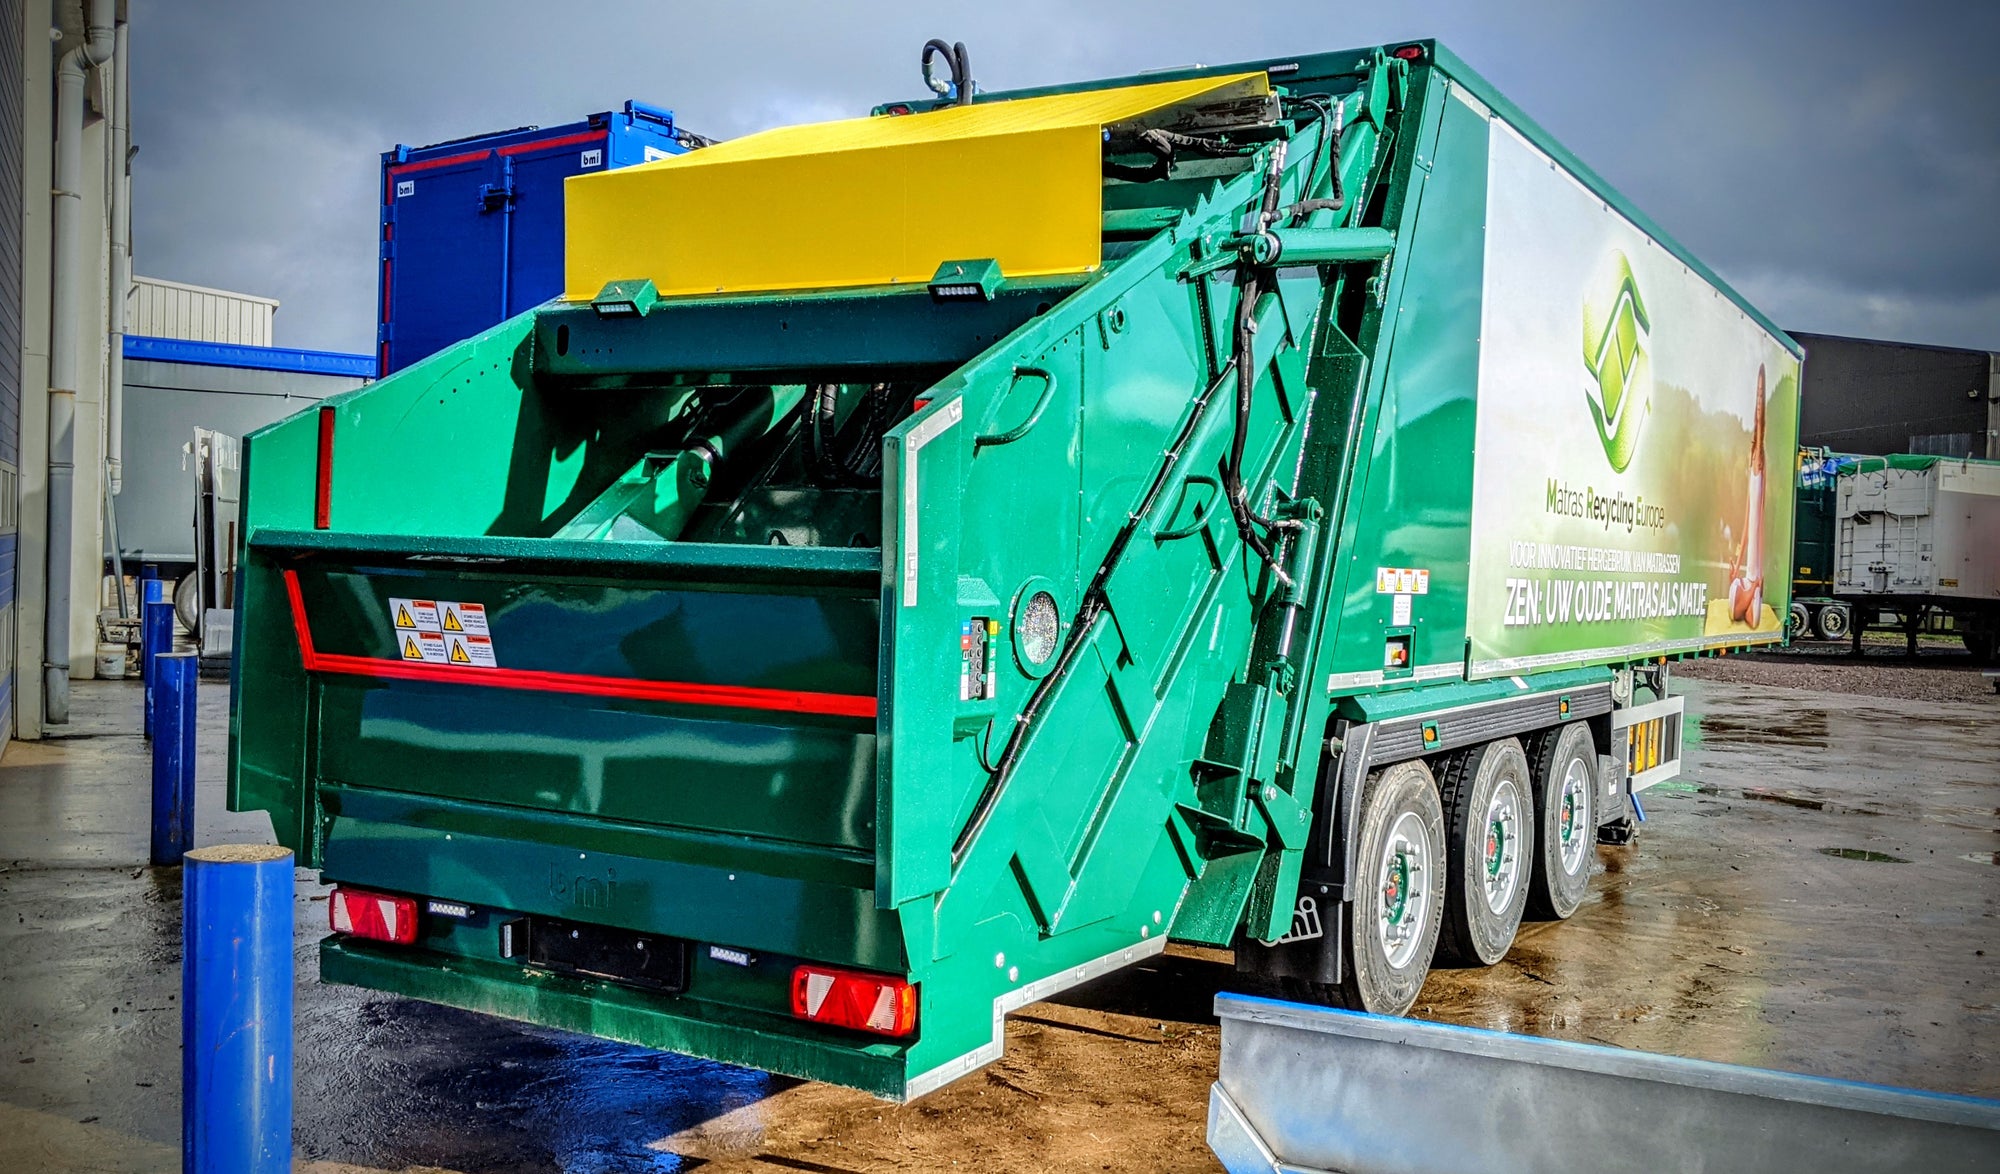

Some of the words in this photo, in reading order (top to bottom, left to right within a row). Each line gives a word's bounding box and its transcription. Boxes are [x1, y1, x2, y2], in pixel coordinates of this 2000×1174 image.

[583, 153, 600, 166] bmi
[399, 183, 413, 195] bmi
[1546, 477, 1583, 517] Matras
[1586, 486, 1634, 533] Recycling
[1636, 496, 1664, 536] Europe
[1509, 541, 1536, 569] VOOR
[1537, 543, 1587, 571] INNOVATIEF
[1587, 547, 1632, 573] HERGEBRUIK
[1633, 551, 1647, 573] VAN
[1504, 577, 1542, 625] ZEN:
[1546, 579, 1574, 624] UW
[1575, 580, 1613, 622] OUDE
[1614, 581, 1659, 620] MATRAS
[1658, 582, 1679, 617] ALS
[1679, 582, 1707, 616] MATJE
[549, 861, 617, 908] bmi
[1258, 896, 1324, 948] mi
